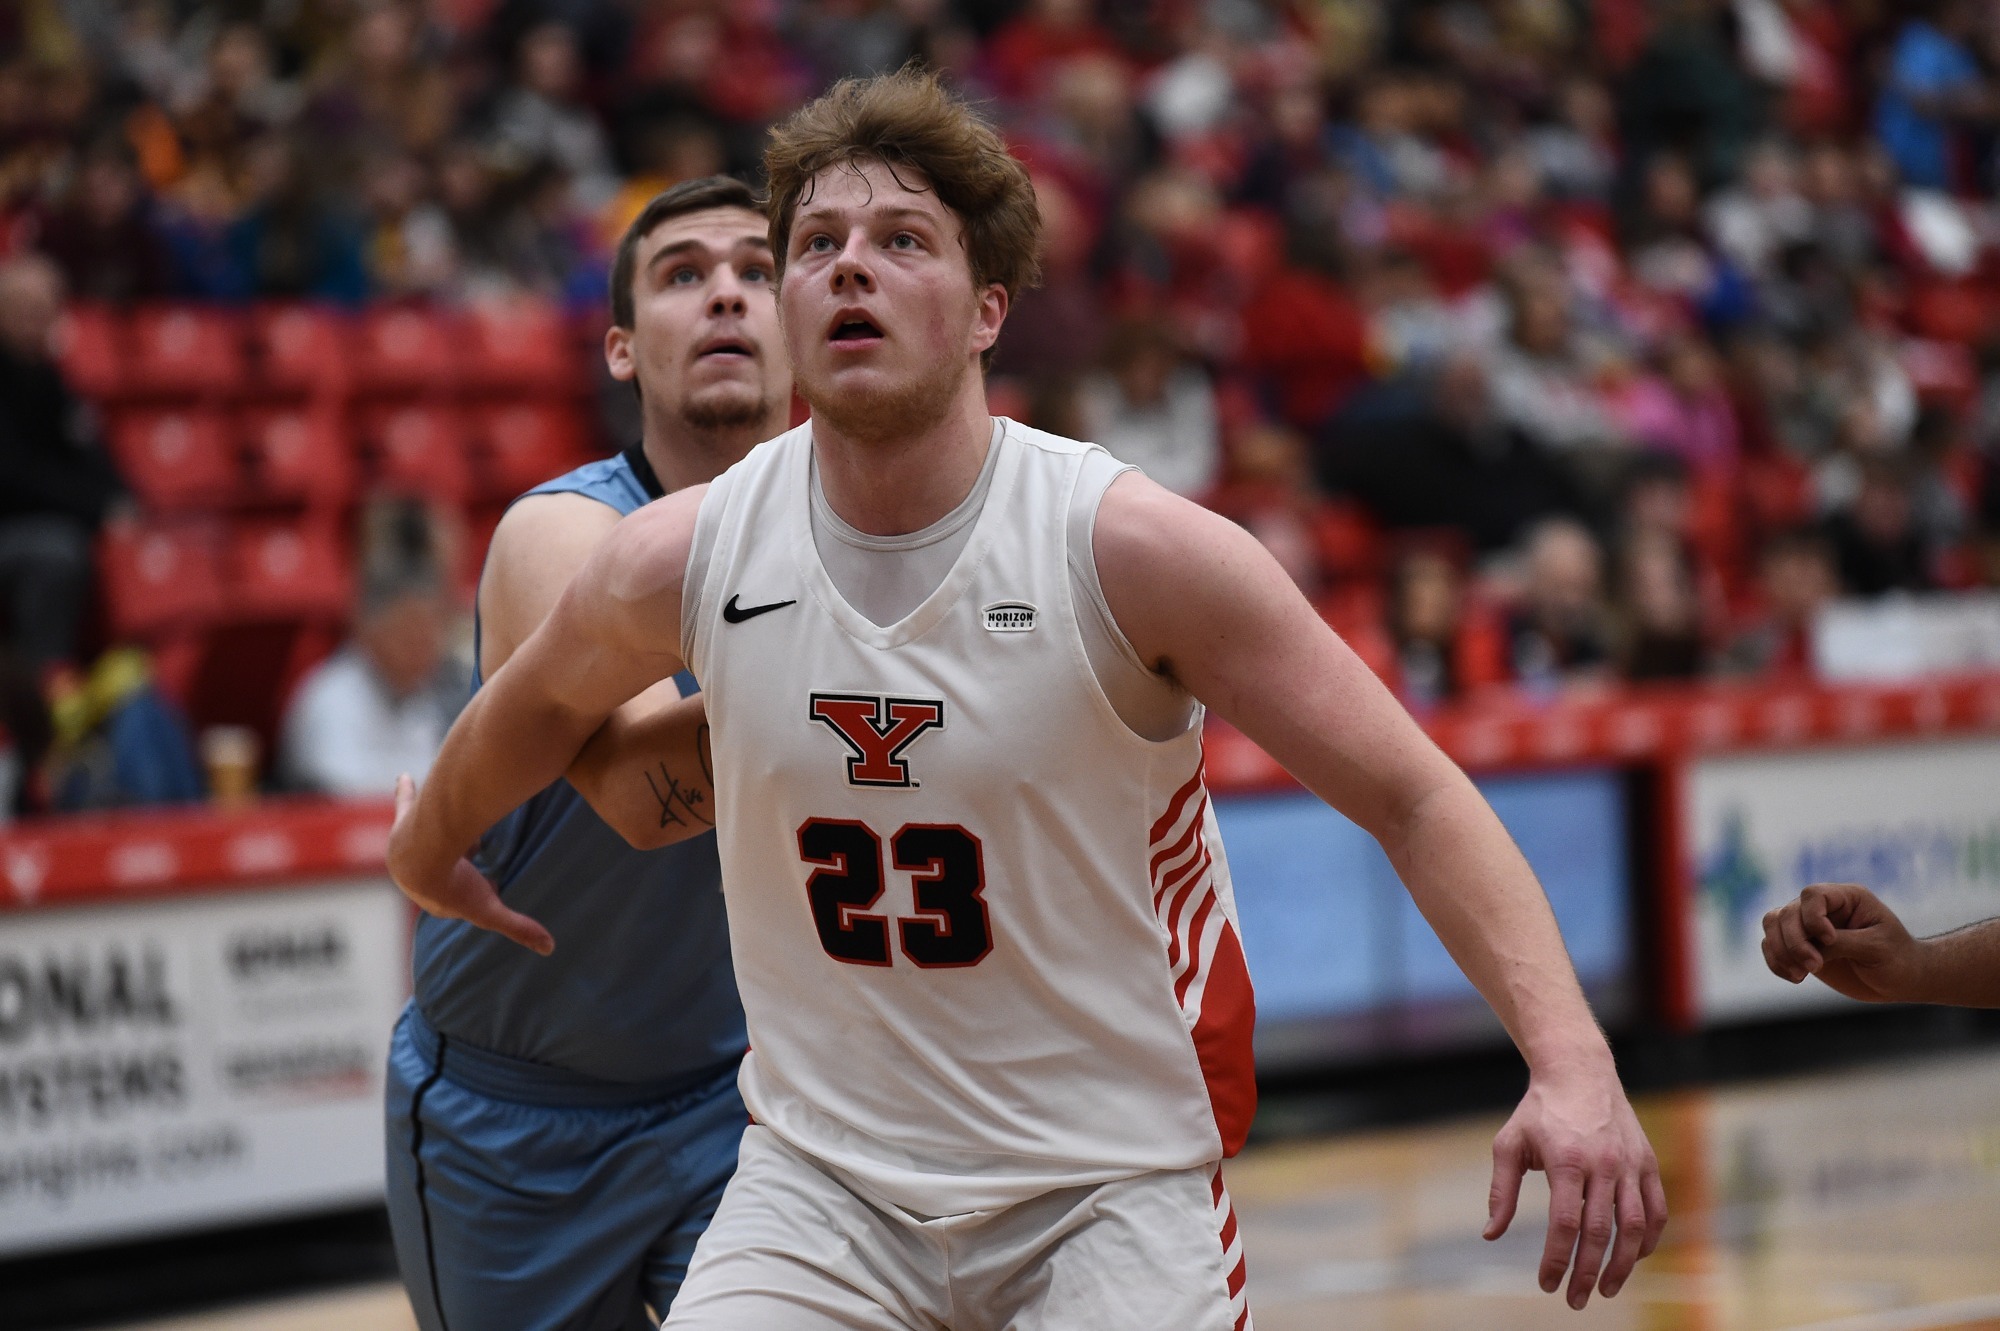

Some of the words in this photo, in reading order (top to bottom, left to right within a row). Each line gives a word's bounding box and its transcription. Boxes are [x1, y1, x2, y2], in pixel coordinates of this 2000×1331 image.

[988, 612, 1033, 621] HORIZON
[809, 693, 944, 787] Y
[796, 816, 994, 969] 23
